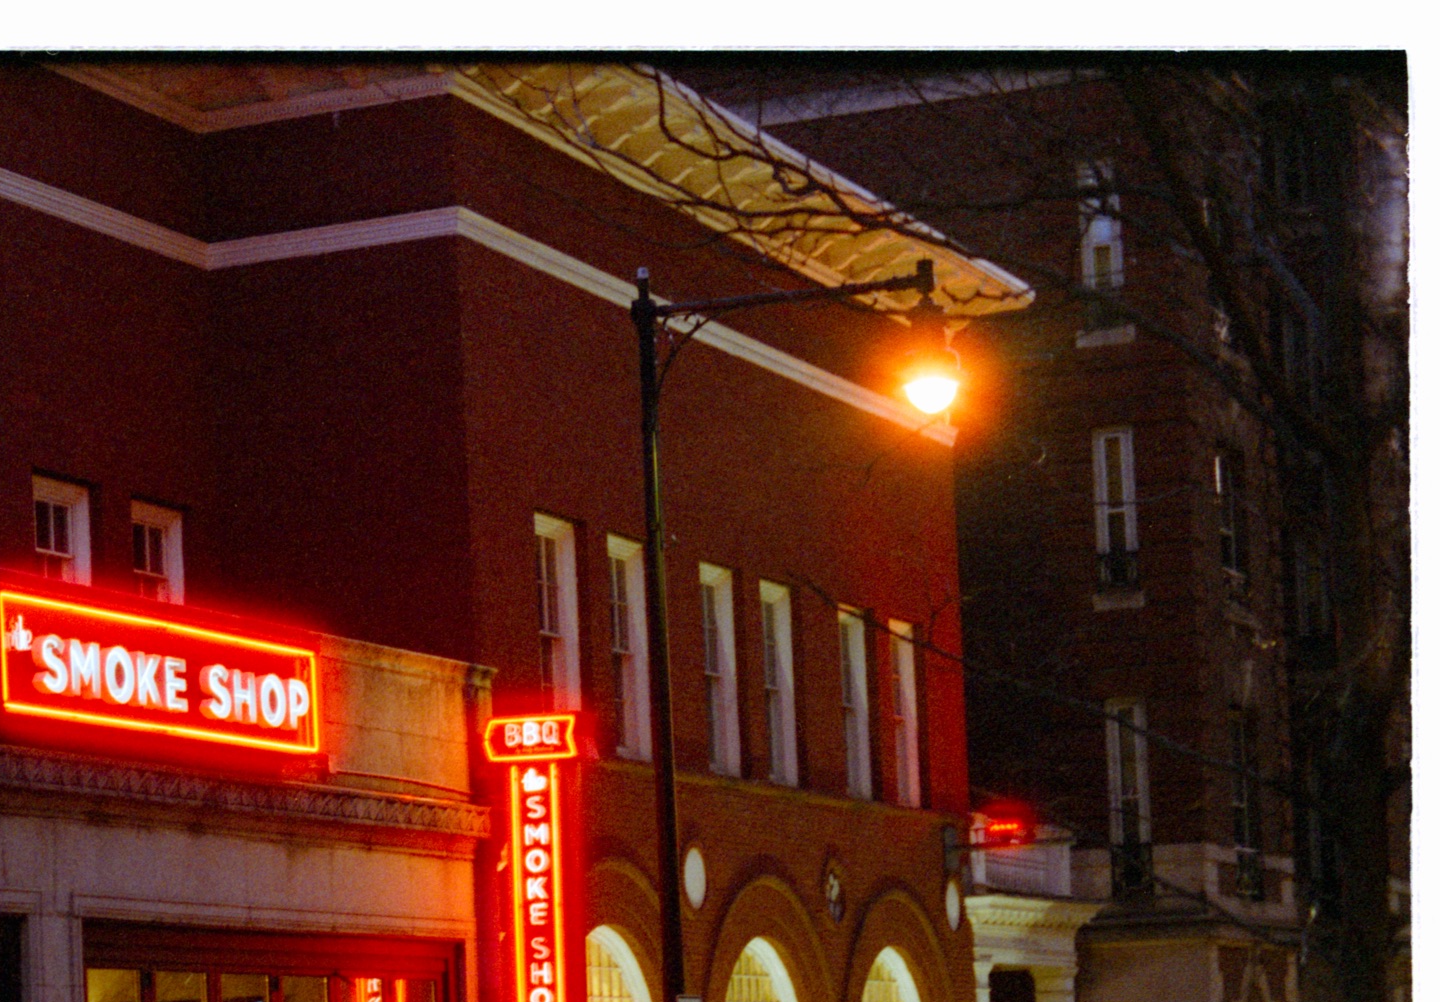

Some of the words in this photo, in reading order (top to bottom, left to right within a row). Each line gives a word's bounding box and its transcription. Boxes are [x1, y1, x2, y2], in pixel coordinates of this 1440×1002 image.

[35, 634, 188, 713] SMOKE
[202, 664, 309, 730] SHOP
[504, 721, 561, 747] BBQ
[523, 795, 550, 926] SMOKE
